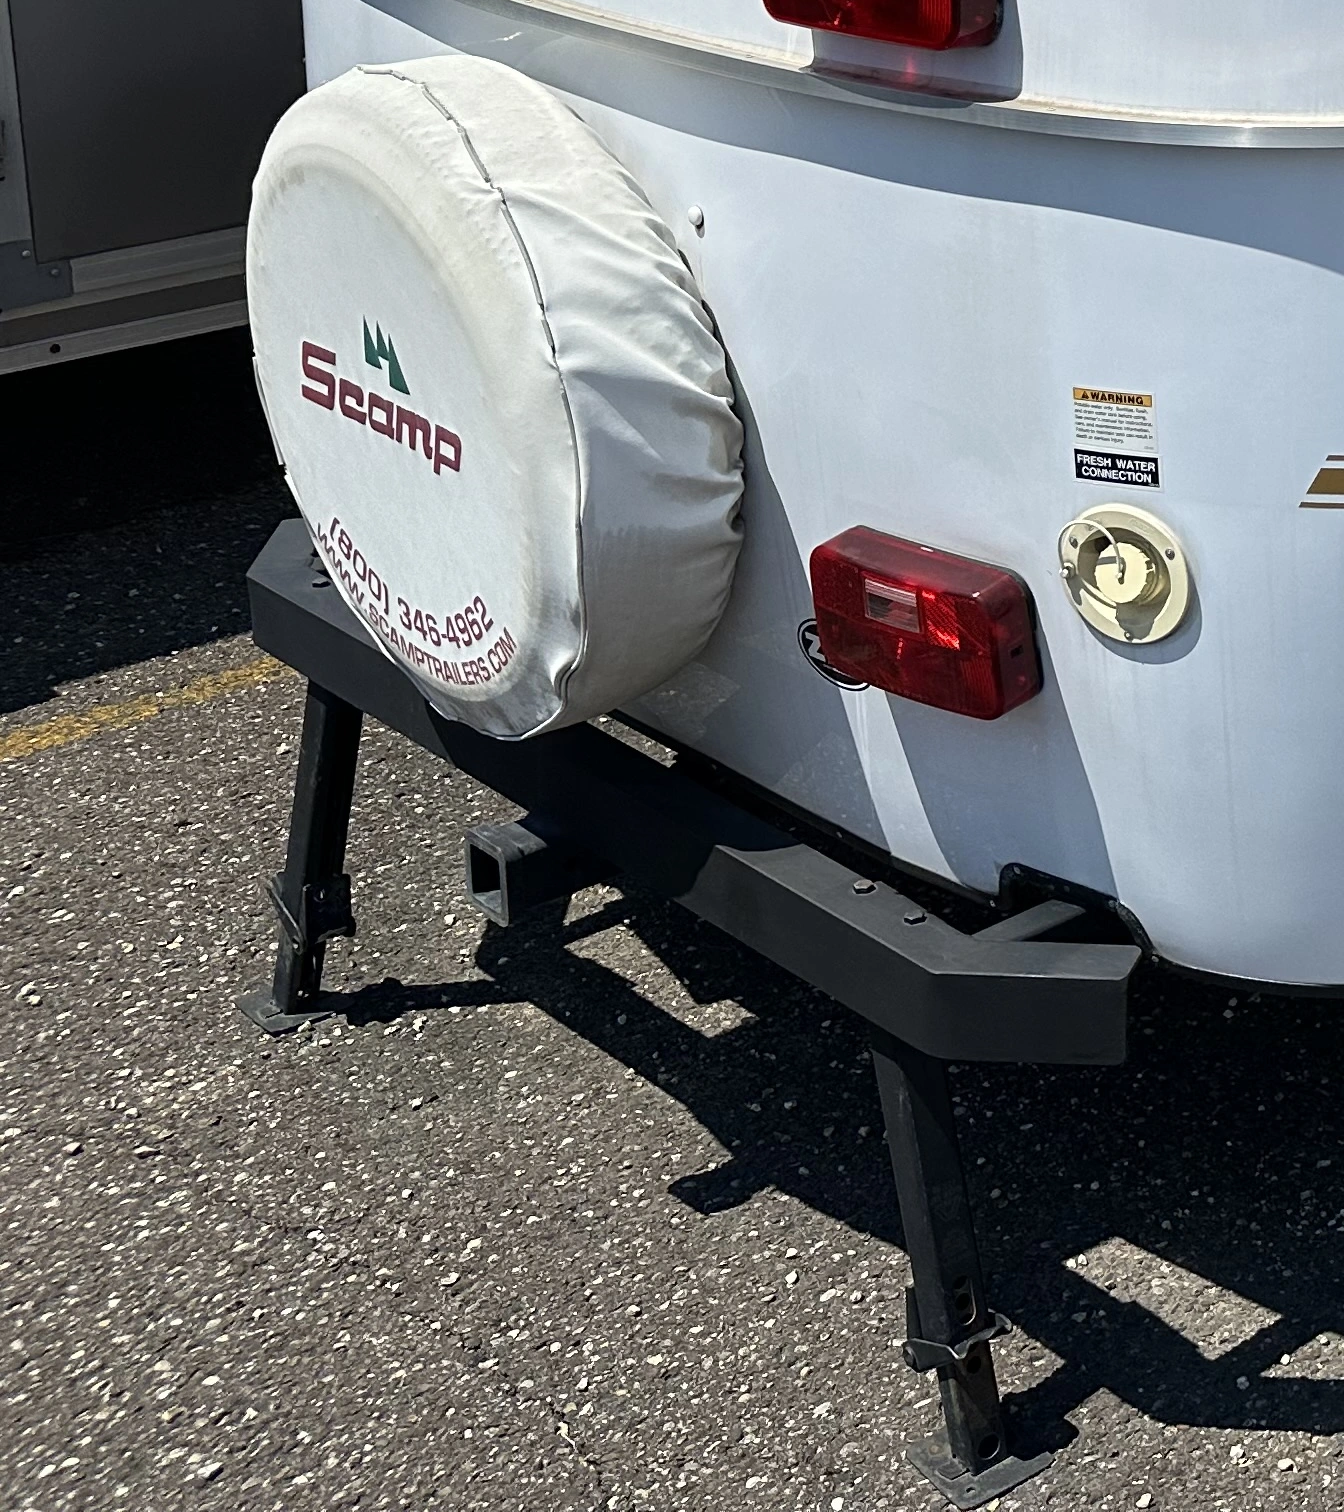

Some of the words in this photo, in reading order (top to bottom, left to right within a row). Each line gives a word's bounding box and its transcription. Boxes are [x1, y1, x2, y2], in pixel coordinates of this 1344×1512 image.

[301, 340, 462, 476] Scamp
[1091, 391, 1144, 405] WARNING
[1076, 453, 1112, 468] FRESH
[1115, 459, 1156, 473] WATER
[1081, 465, 1152, 484] CONNECTION
[329, 516, 389, 616] (800)
[397, 594, 494, 650] 346-4962
